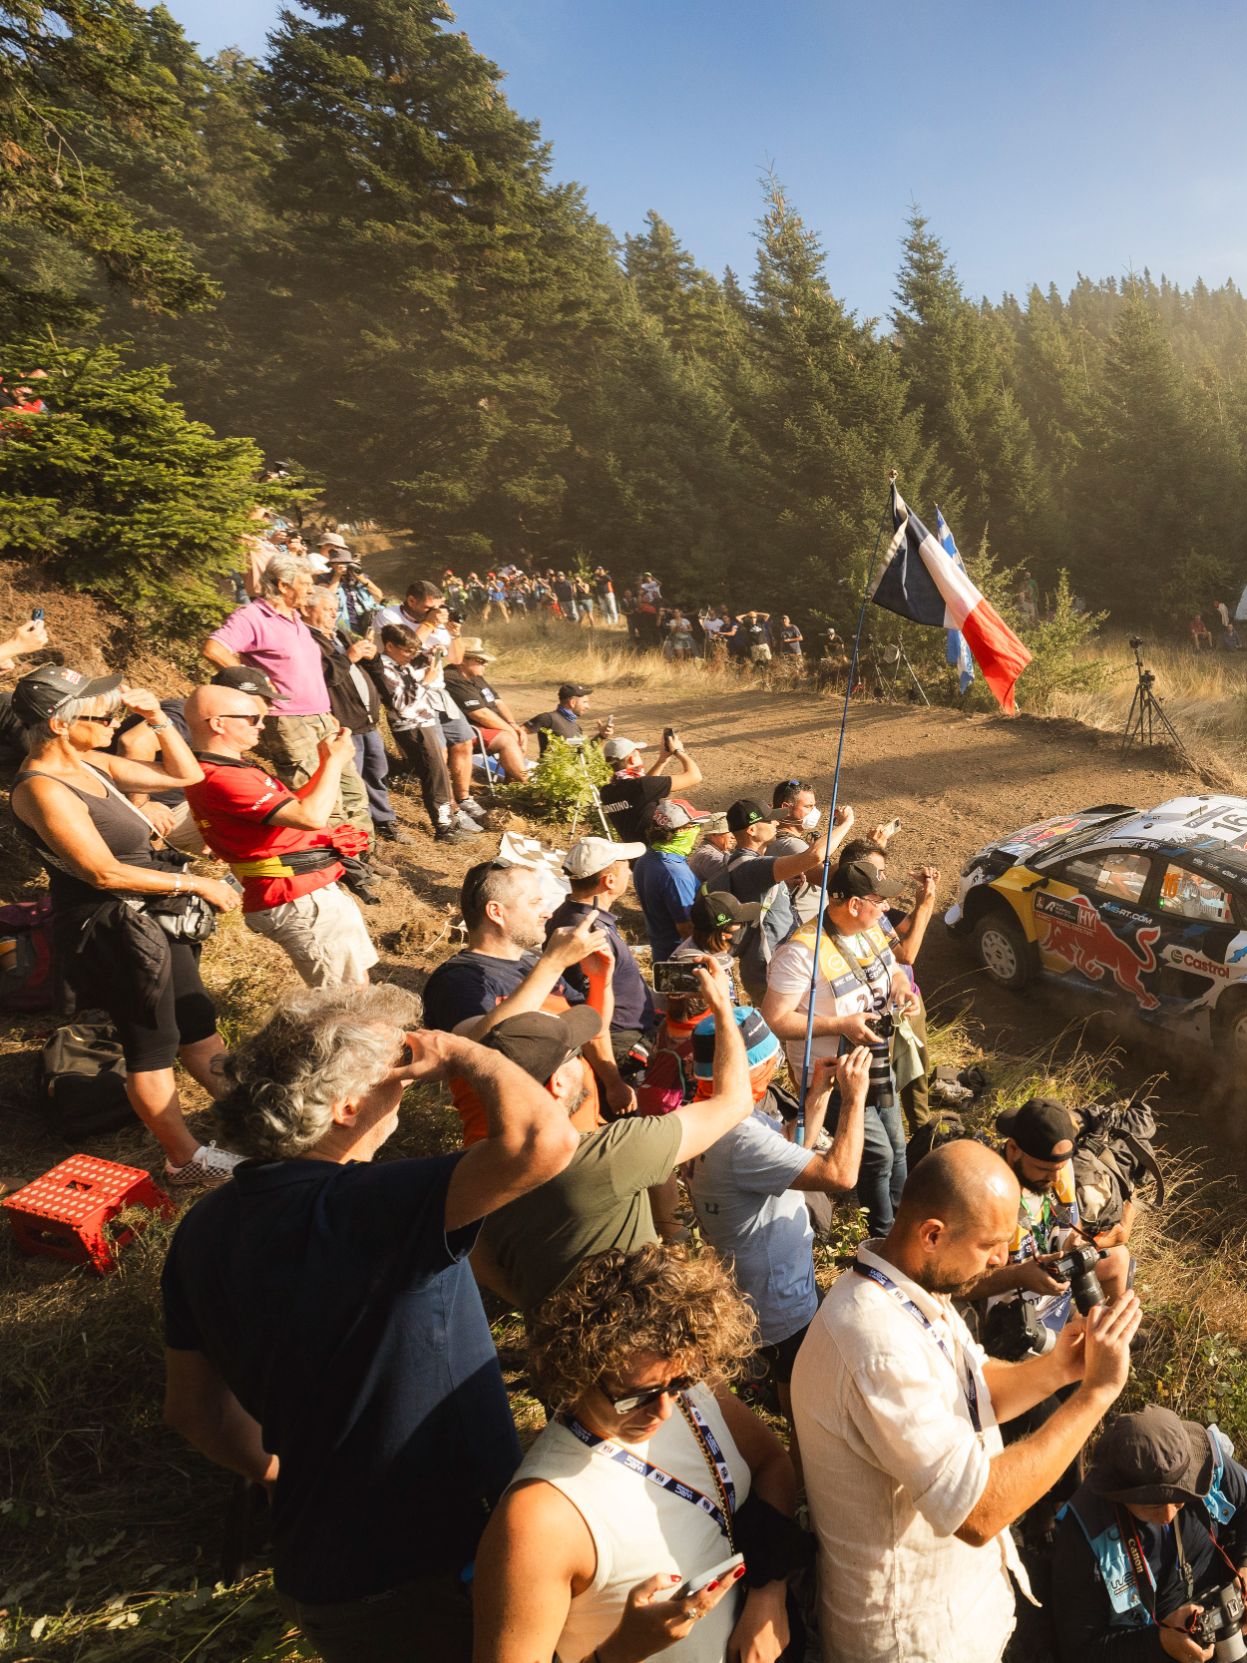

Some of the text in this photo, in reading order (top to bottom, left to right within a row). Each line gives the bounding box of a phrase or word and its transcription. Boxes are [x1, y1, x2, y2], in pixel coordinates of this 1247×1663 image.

[1164, 872, 1179, 899] 16
[1079, 908, 1096, 929] HY
[1183, 953, 1230, 979] Castrol
[870, 1268, 888, 1281] WRC
[1128, 1538, 1144, 1574] Canon
